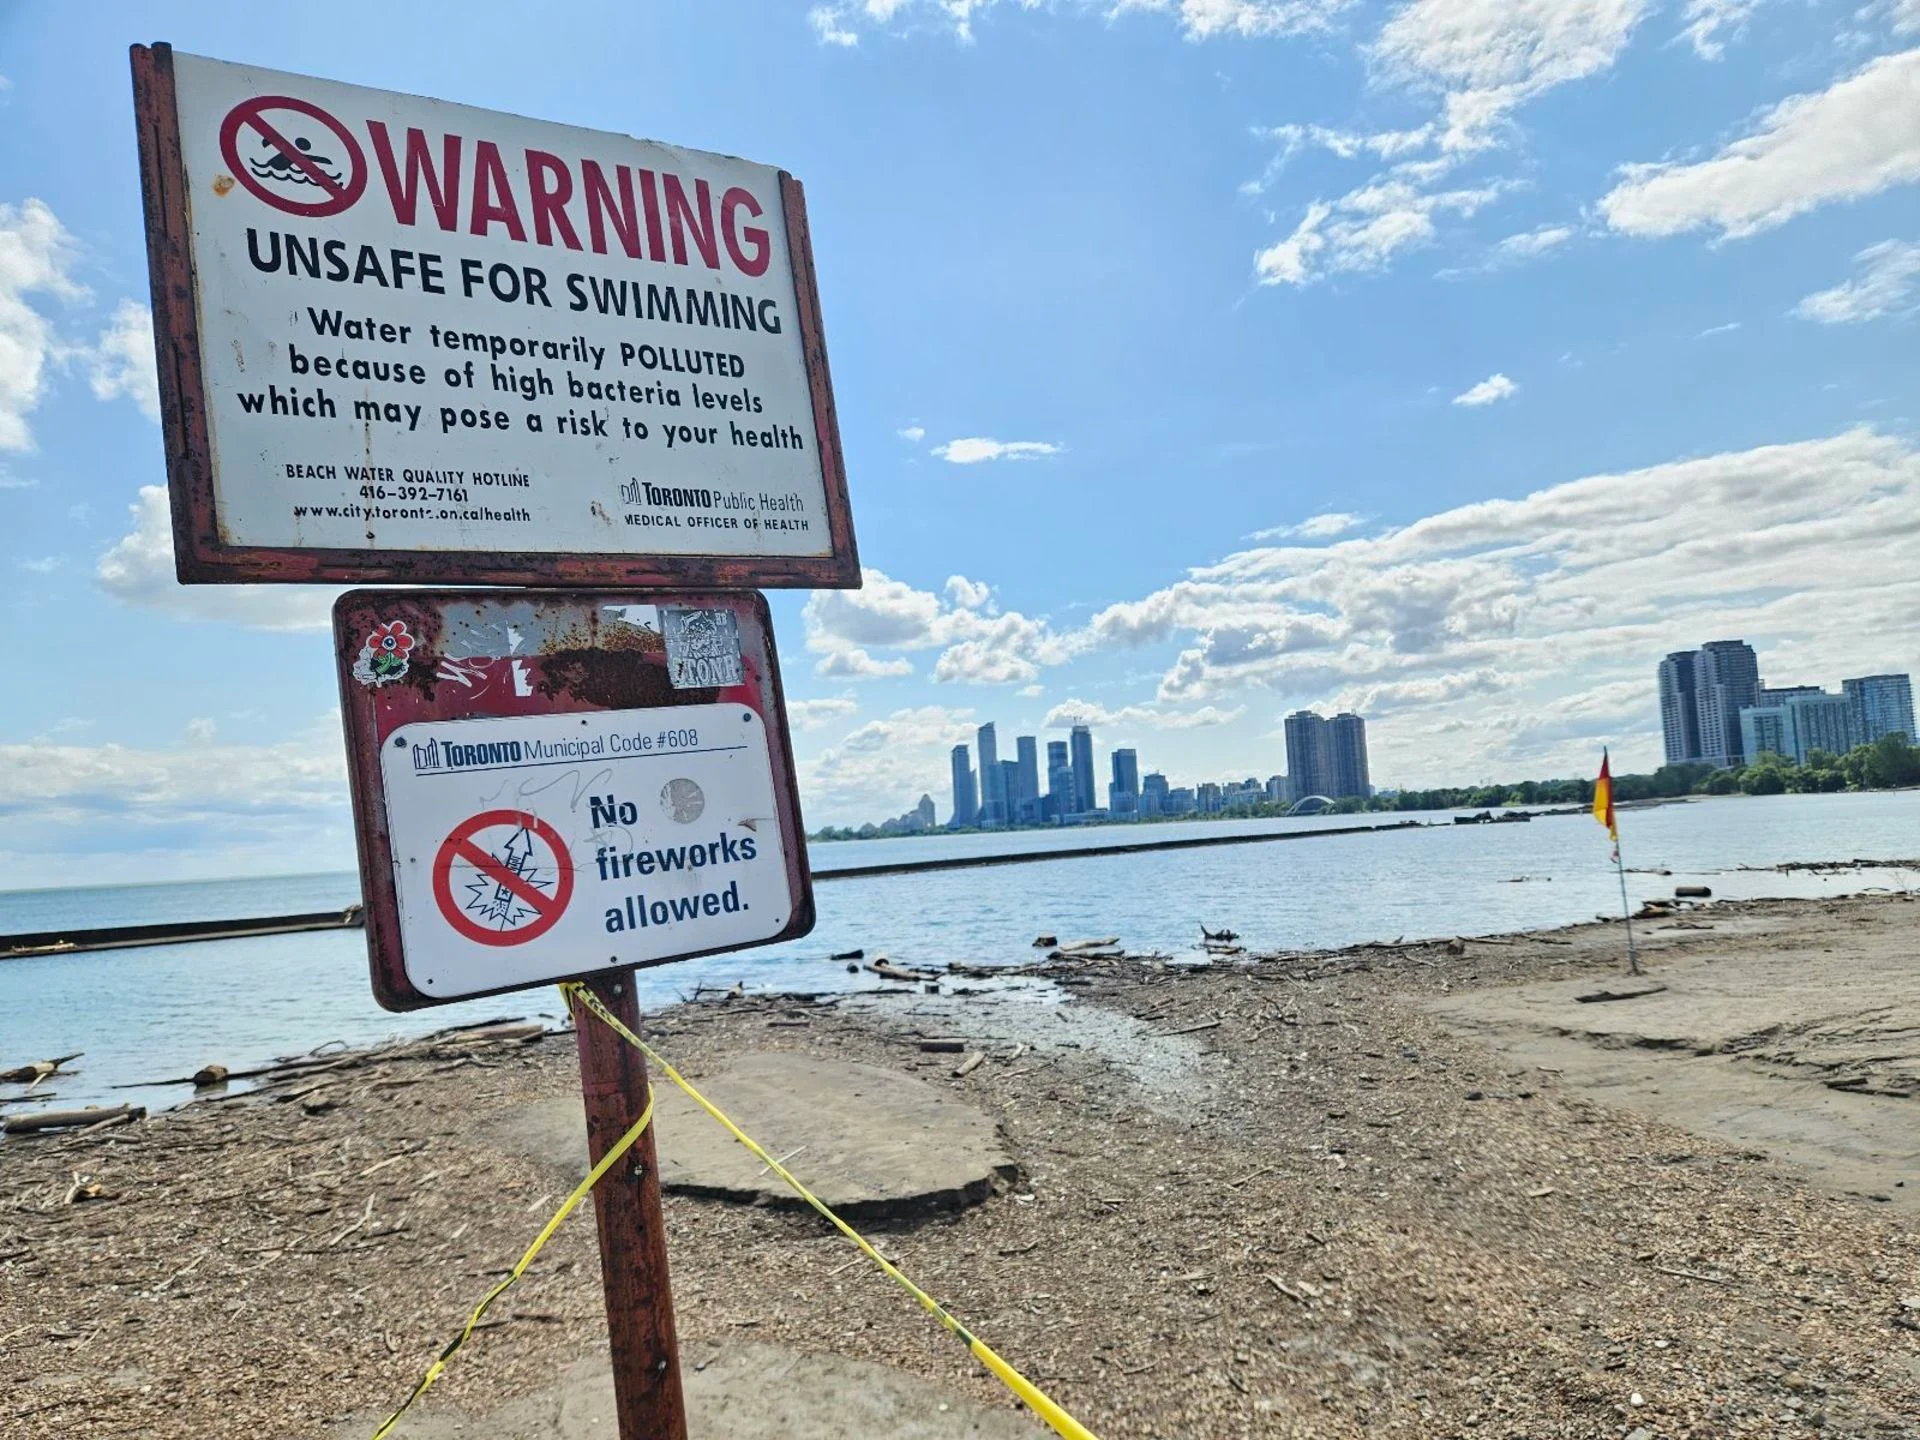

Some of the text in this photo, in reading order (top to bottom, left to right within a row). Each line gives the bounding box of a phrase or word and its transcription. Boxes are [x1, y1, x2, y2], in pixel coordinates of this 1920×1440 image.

[365, 119, 771, 277] WARNING
[246, 228, 782, 334] UNSAFE FOR SWIMMING
[307, 306, 745, 378] Water temporarily POLLUTED
[289, 343, 763, 413] because of high bacteria levels
[237, 384, 804, 450] which may pose a risk to your health
[286, 464, 530, 487] BEACH WATER QUALITY HOTLINE
[360, 486, 469, 502] 416-392-7161
[641, 482, 804, 512] TORONTO Public Health
[625, 514, 809, 531] MEDICAL OFFICER OF HEALTH
[442, 729, 698, 768] TORONTO Municipal Code #608
[590, 795, 638, 829] No
[596, 832, 758, 881] fireworks
[605, 881, 749, 933] allowed.
